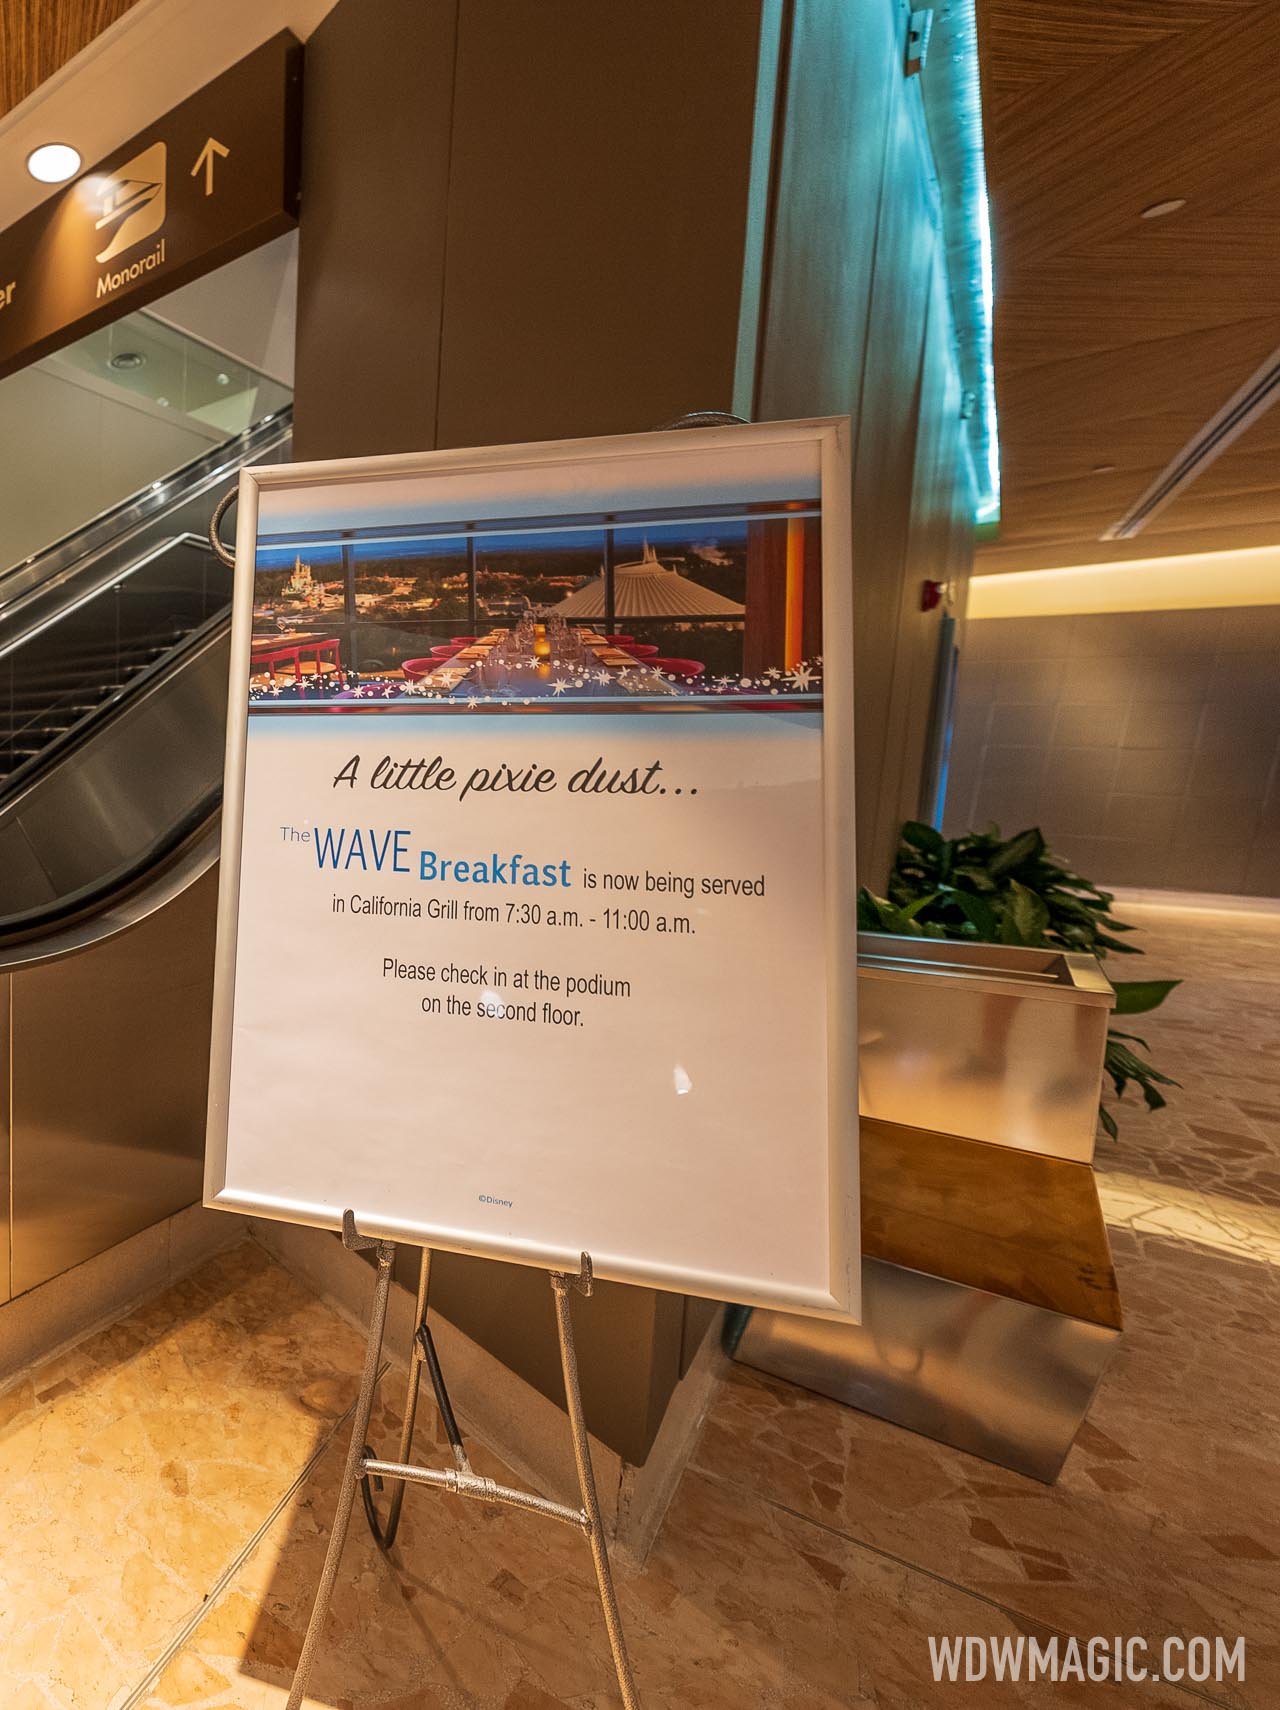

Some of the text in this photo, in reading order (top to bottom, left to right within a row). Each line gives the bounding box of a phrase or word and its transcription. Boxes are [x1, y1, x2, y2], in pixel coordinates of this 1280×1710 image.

[96, 238, 166, 299] Monorail
[332, 754, 698, 802] A little pixie dust...
[280, 826, 765, 899] The WAVE Breakfast is now being served
[332, 893, 345, 913] in
[350, 894, 422, 917] California
[427, 898, 458, 920] Grill
[463, 900, 499, 922] from
[505, 902, 541, 925] 7:30
[546, 910, 583, 927] a.m.
[603, 907, 650, 931] 11:00
[656, 916, 696, 934] a.m.
[382, 957, 631, 998] Please check in at the podium
[421, 994, 584, 1027] on the second floor.
